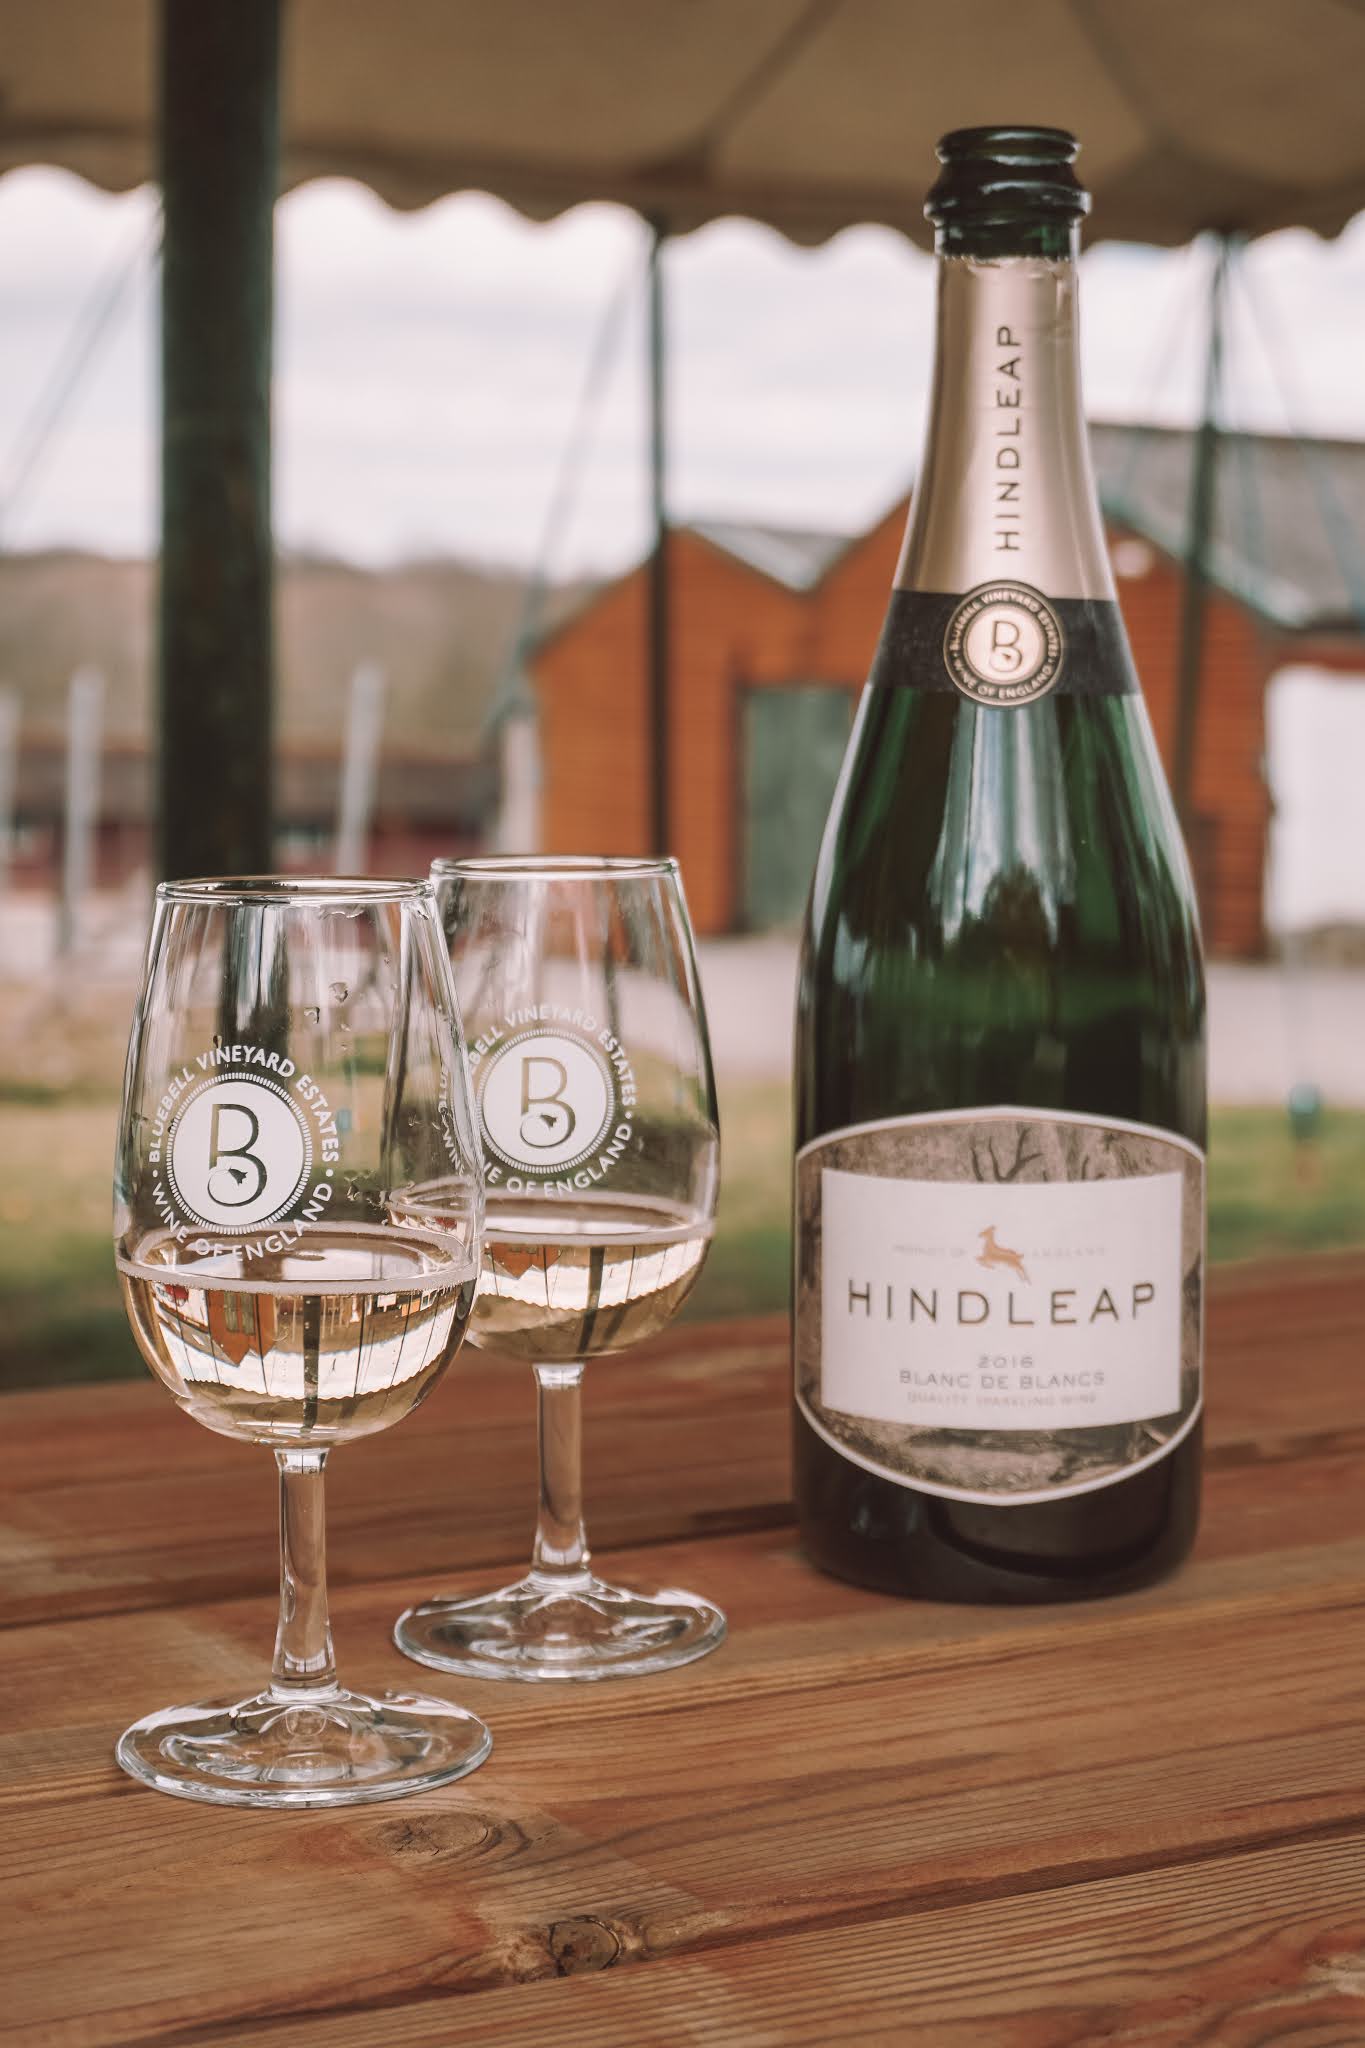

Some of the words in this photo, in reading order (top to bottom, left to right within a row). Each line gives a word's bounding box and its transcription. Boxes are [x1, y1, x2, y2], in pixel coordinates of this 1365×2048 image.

[996, 325, 1022, 551] HINDLEAP
[981, 591, 1042, 613] VINEYARD
[1037, 608, 1059, 658] ESTATES
[989, 620, 1023, 673] B
[977, 685, 997, 697] OF
[998, 664, 1053, 699] ENGLAND
[504, 1006, 598, 1032] VINEYARD
[598, 1029, 636, 1106] ESTATES
[148, 1067, 196, 1163] BLUEBELL
[195, 1044, 297, 1078] VINEYARD
[295, 1074, 340, 1163] ESTATES
[519, 1056, 577, 1149] B
[207, 1103, 268, 1208] B
[506, 1177, 536, 1196] OF
[543, 1123, 633, 1198] ENGLAND
[151, 1181, 190, 1244] WINE
[194, 1237, 225, 1259] OF
[231, 1182, 333, 1262] ENGLAND
[847, 1278, 1156, 1326] HINDLEAP
[899, 1369, 970, 1389] BLANC
[980, 1375, 1009, 1390] DE
[1019, 1371, 1105, 1390] BLANCS
